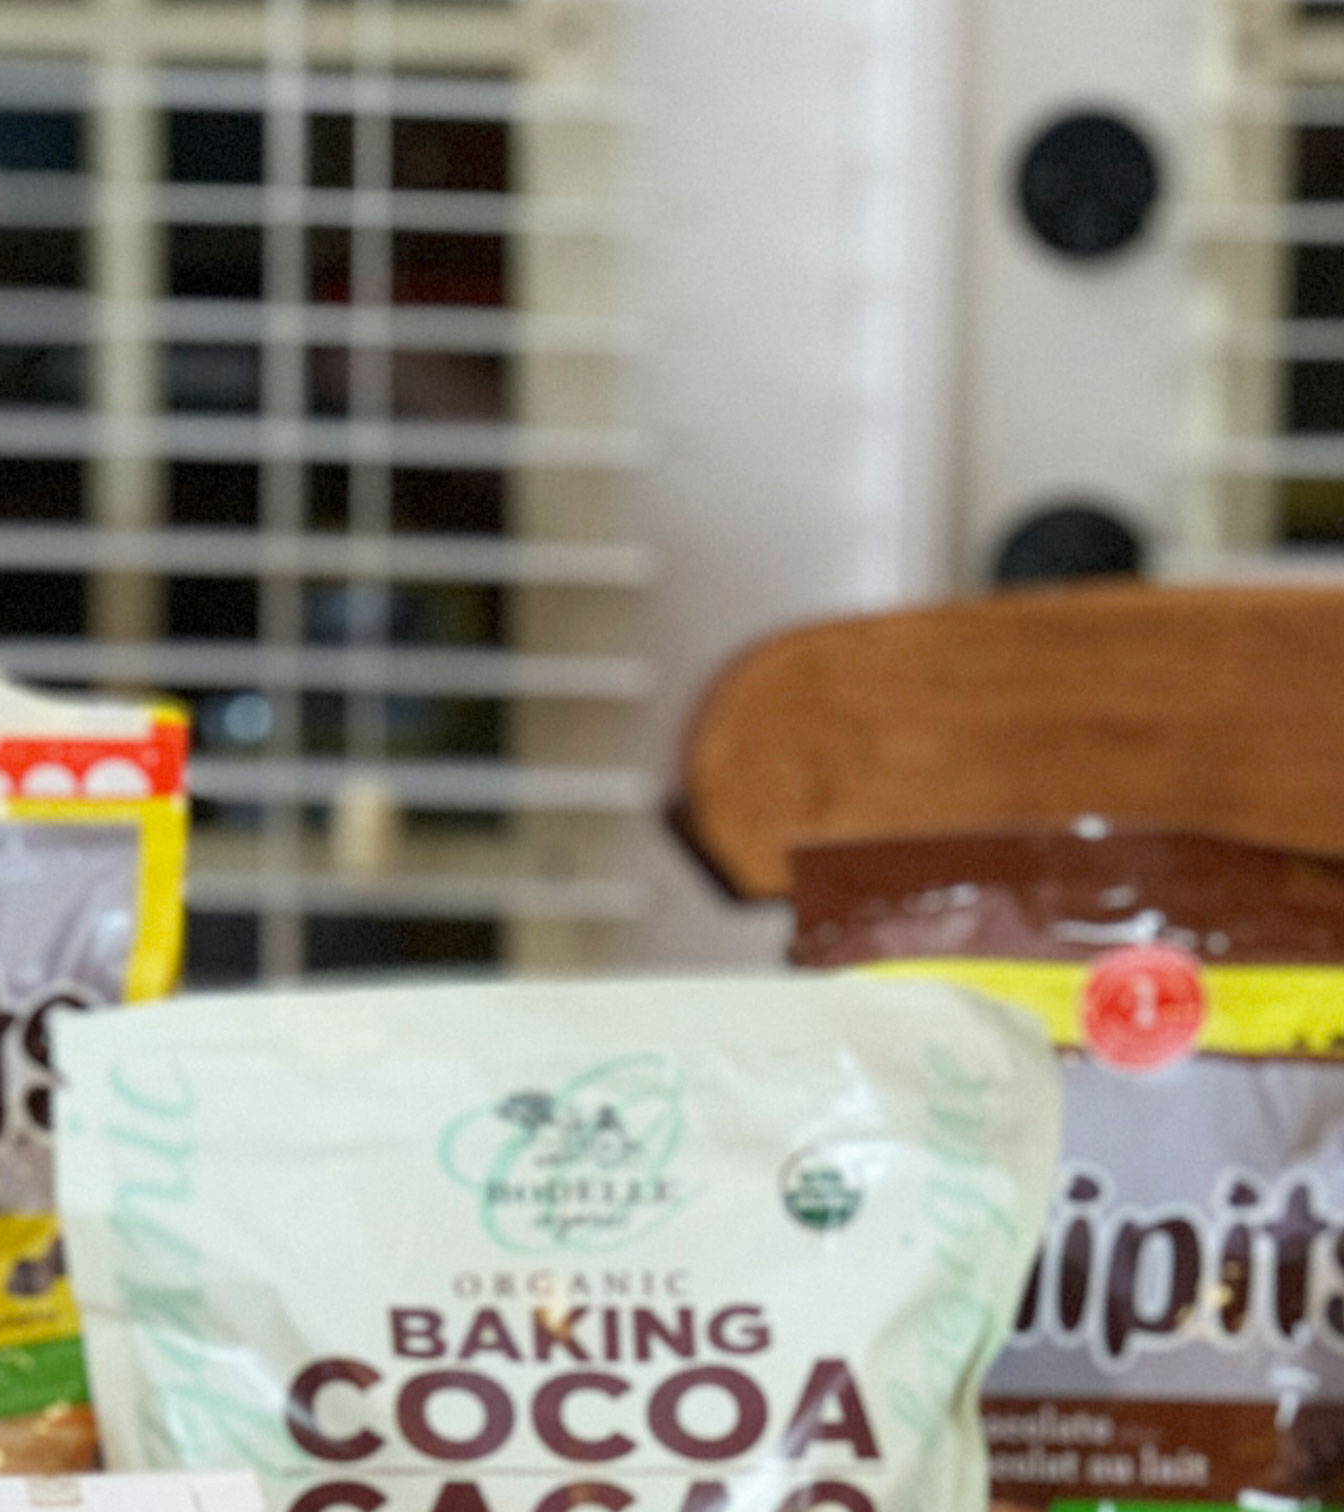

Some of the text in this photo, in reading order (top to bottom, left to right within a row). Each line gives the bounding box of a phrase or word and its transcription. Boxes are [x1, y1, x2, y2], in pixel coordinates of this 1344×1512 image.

[451, 1268, 692, 1297] ORGANIC
[389, 1305, 772, 1361] BAKING
[283, 1359, 882, 1463] COCOA
